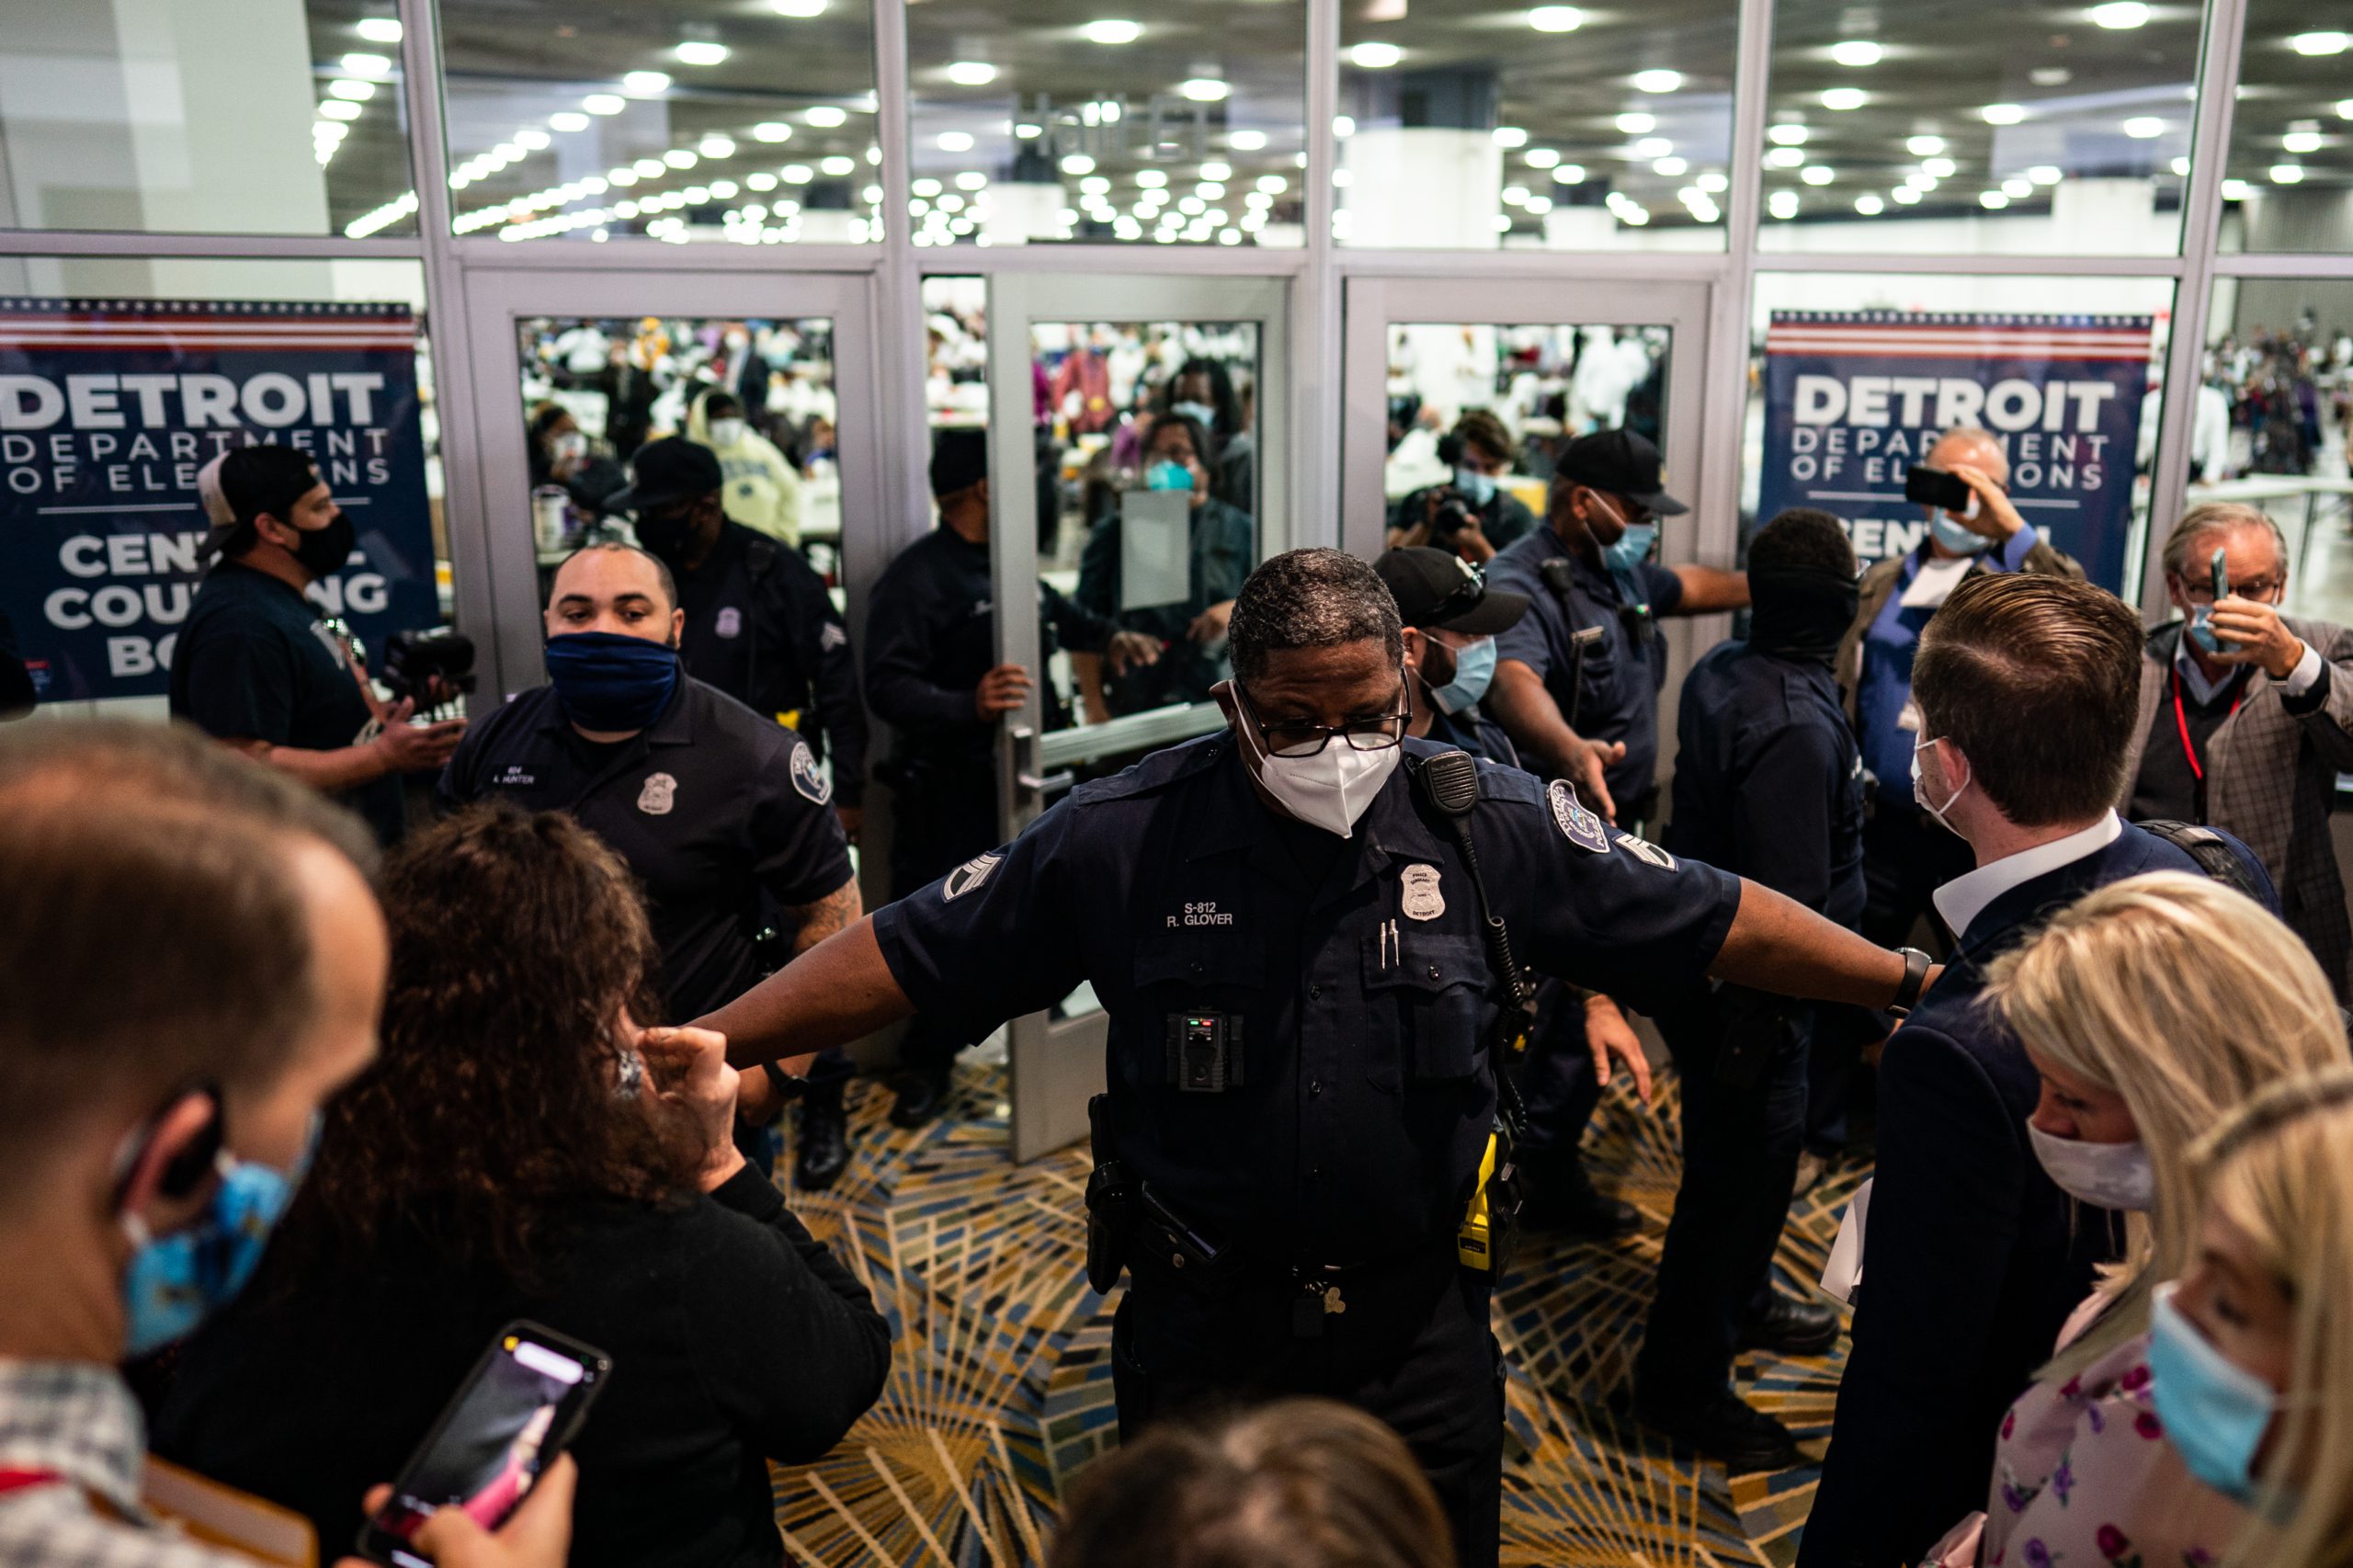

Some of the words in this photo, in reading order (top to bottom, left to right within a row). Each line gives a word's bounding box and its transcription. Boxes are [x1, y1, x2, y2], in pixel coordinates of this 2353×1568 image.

[0, 373, 385, 431] DETROIT
[1793, 375, 2117, 433] DETROIT
[8, 464, 76, 494] OF
[108, 459, 391, 493] ELENS
[1790, 455, 1843, 483] OF
[1865, 457, 2103, 491] ELONS
[44, 574, 389, 630] COUNG
[1166, 915, 1180, 928] R.
[1184, 913, 1233, 926] GLOVER
[1184, 902, 1216, 915] S-812
